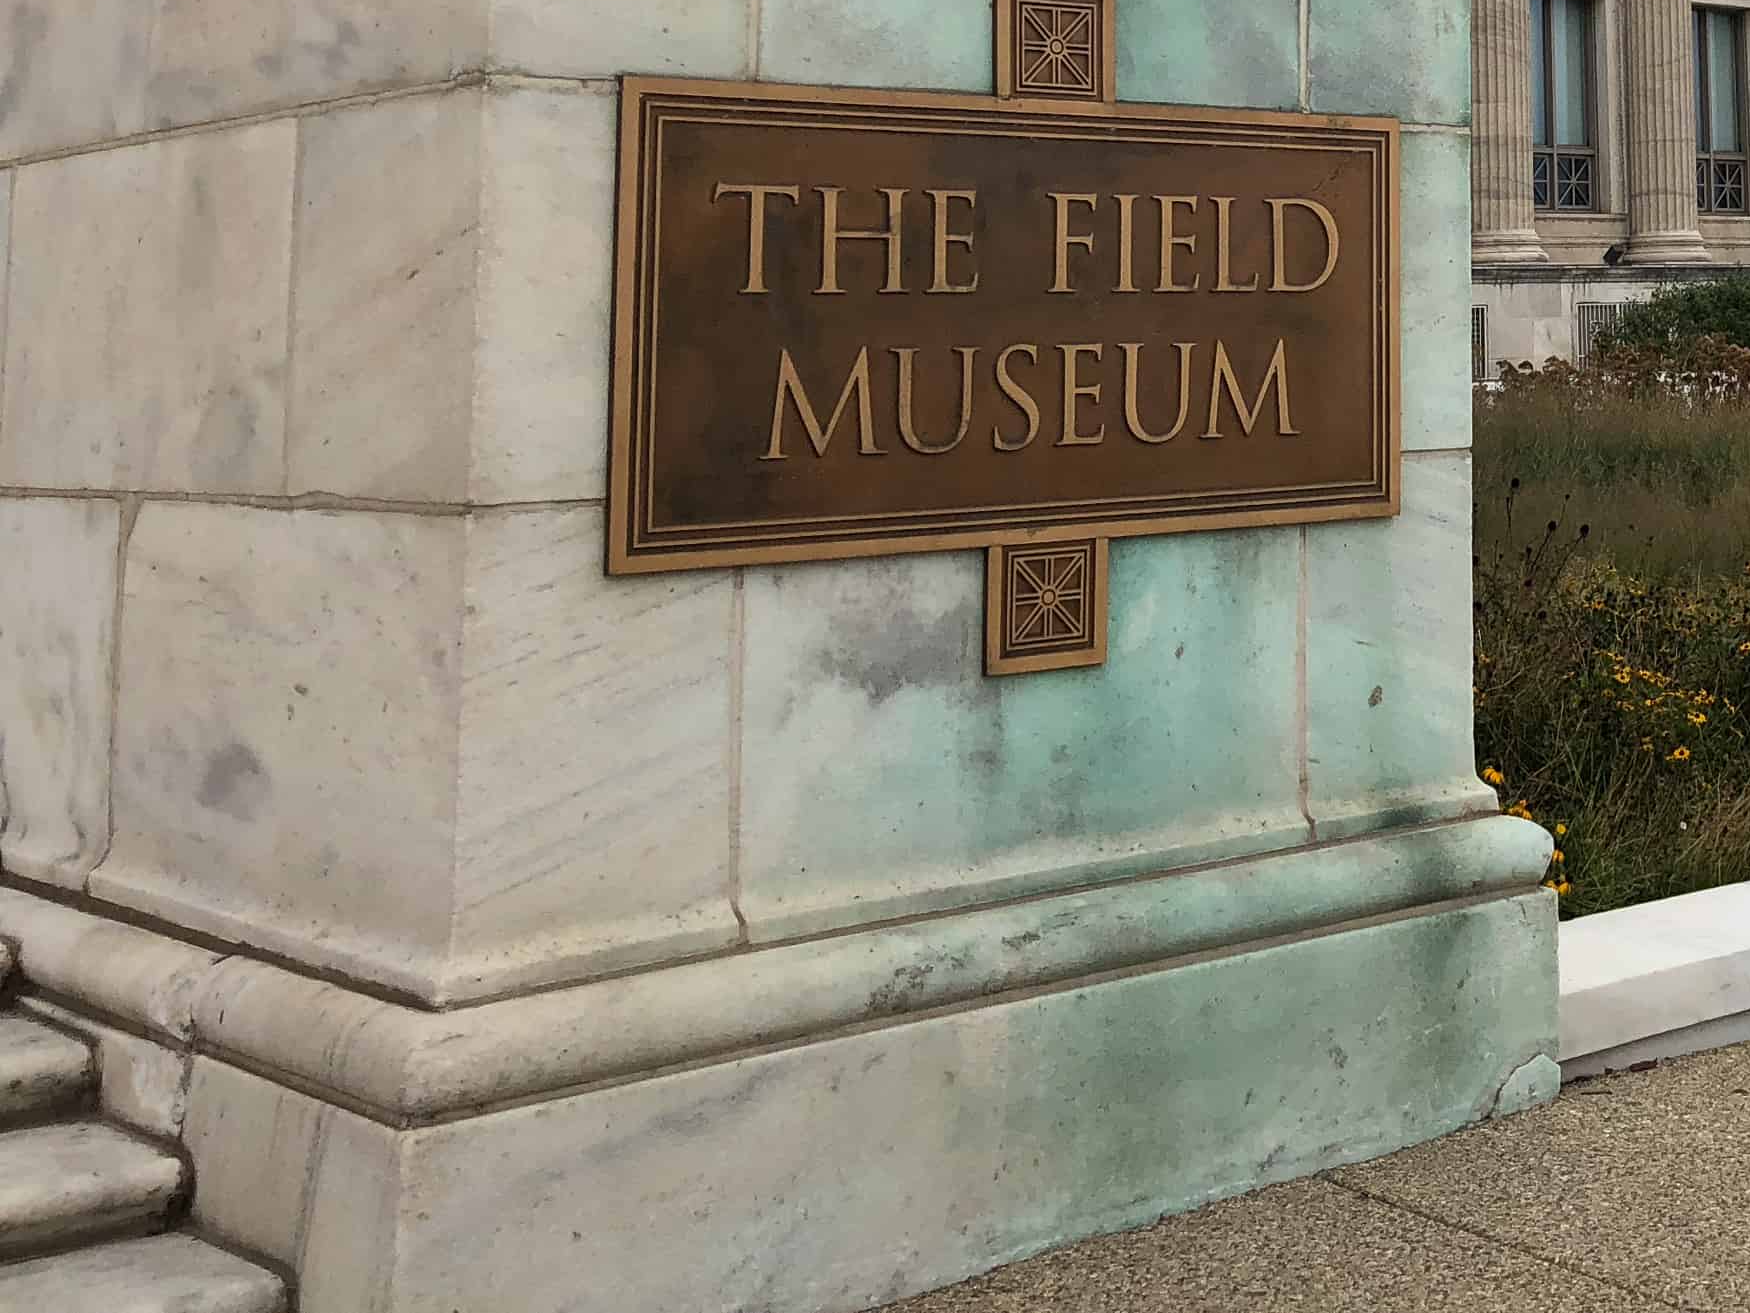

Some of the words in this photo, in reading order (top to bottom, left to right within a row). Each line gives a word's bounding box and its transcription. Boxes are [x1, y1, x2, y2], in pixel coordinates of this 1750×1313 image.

[712, 182, 979, 294] THE
[1046, 192, 1340, 293] FIELD
[758, 338, 1301, 461] MUSEUM
